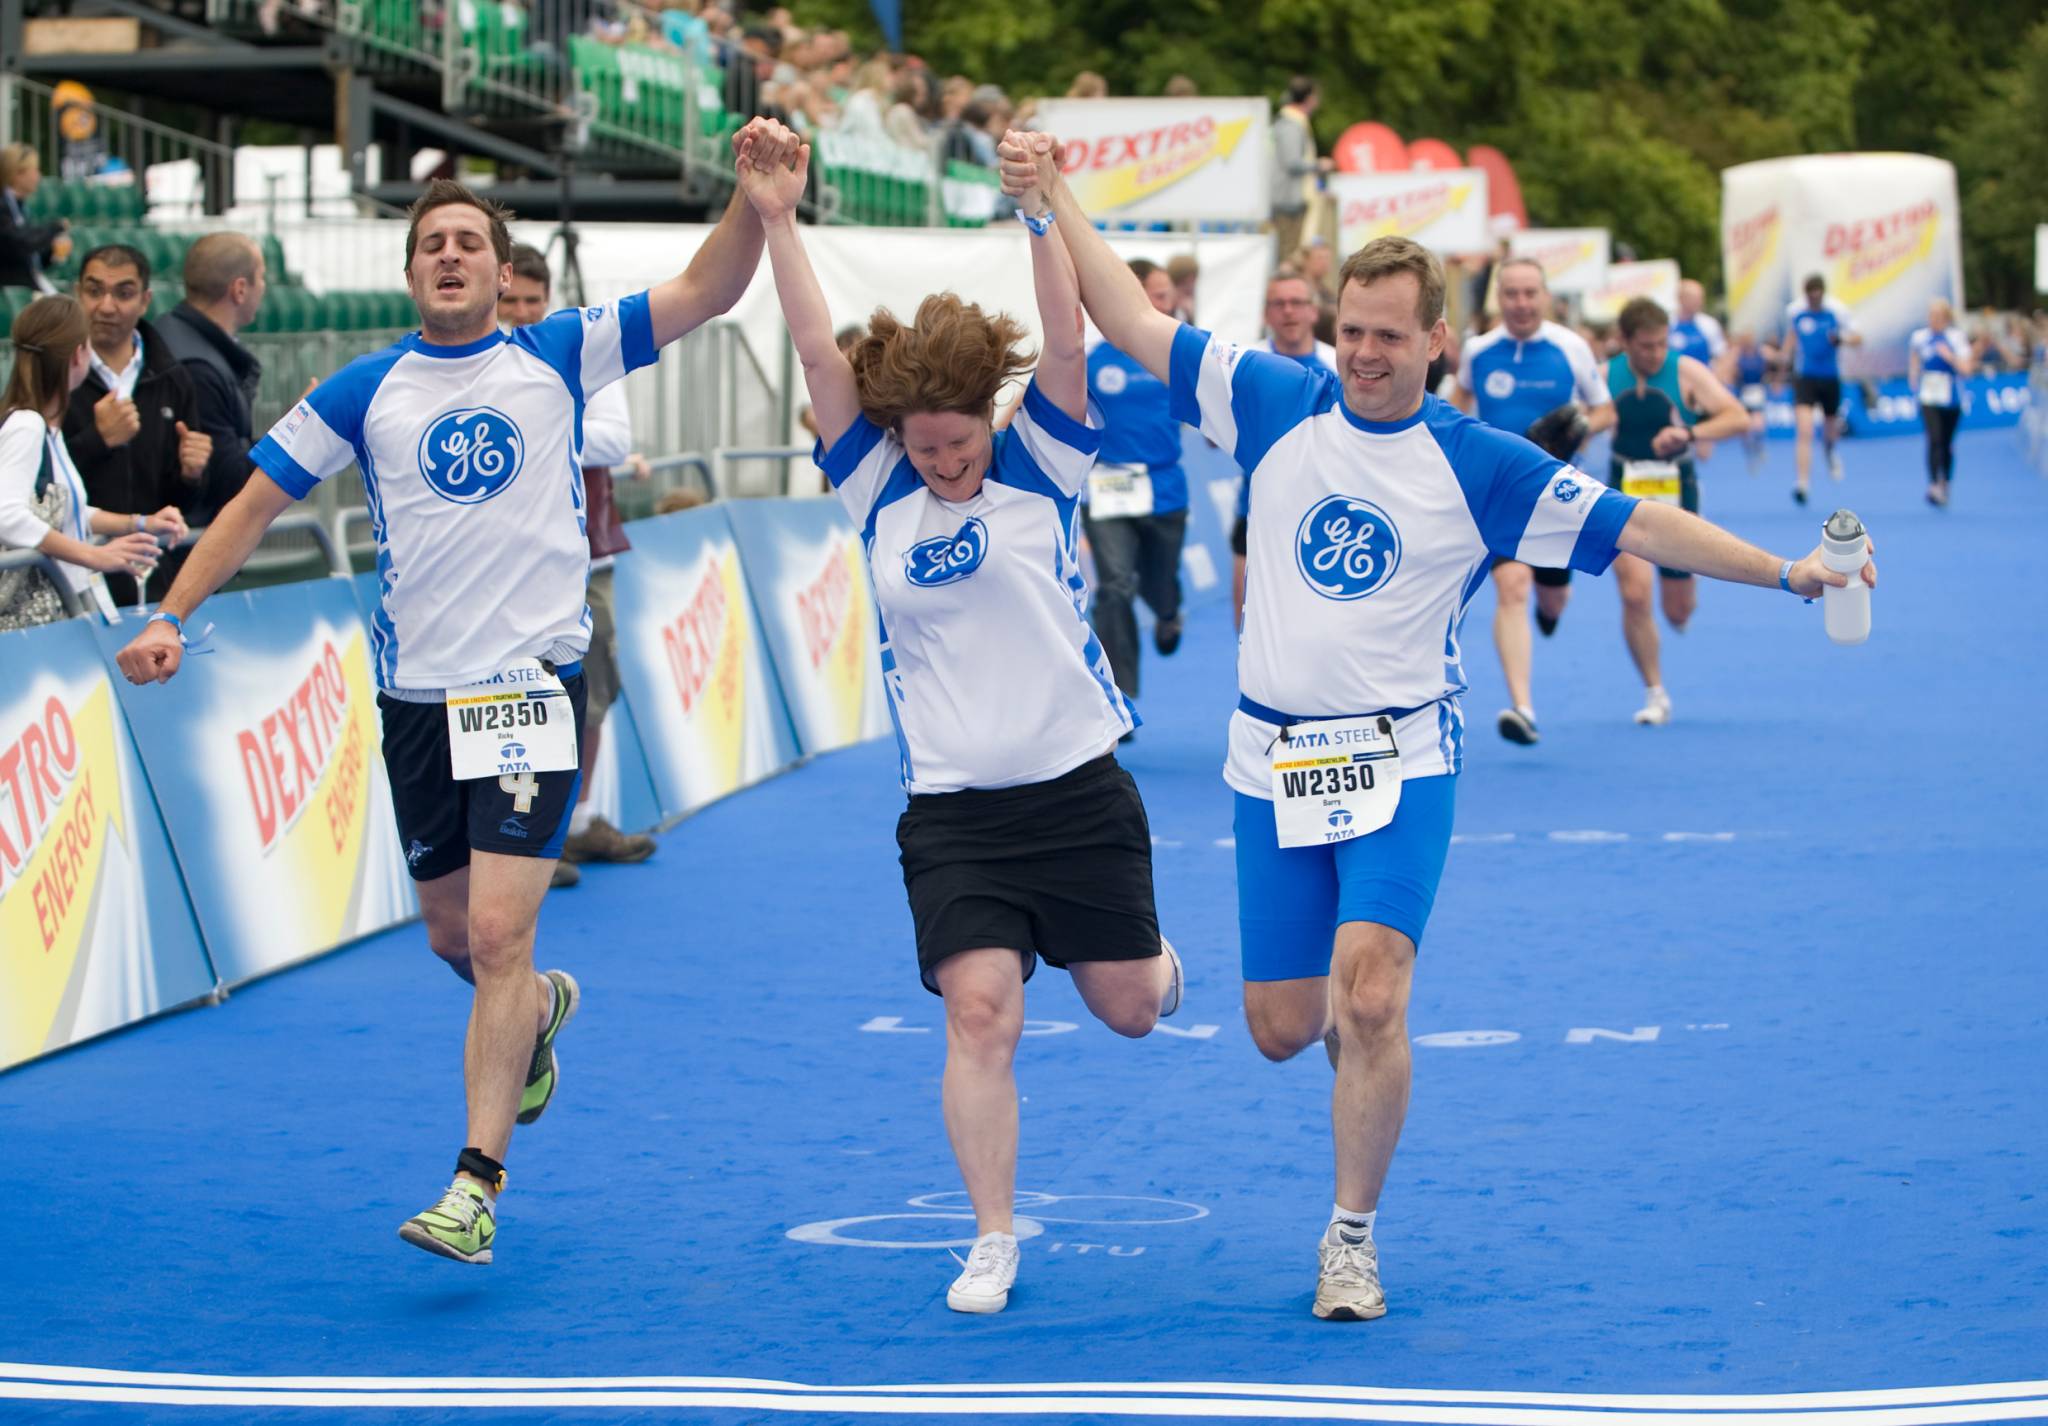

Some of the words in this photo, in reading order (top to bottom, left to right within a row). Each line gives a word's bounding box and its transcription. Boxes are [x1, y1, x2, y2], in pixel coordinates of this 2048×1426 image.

[1061, 115, 1216, 175] DEXTRO
[1823, 200, 1935, 258] DEXTRO
[663, 557, 725, 715] DEXTRO
[459, 701, 548, 733] W2350
[237, 640, 346, 847] DEXTRO
[1287, 733, 1329, 749] TATA
[1335, 729, 1380, 745] STEEL
[498, 762, 531, 773] TATA
[1283, 764, 1375, 798] W2350
[0, 696, 77, 888] TRO
[1323, 799, 1341, 807] Barry
[1325, 829, 1355, 842] TATA
[32, 768, 97, 951] ENERGY
[1048, 1243, 1147, 1257] ITU
